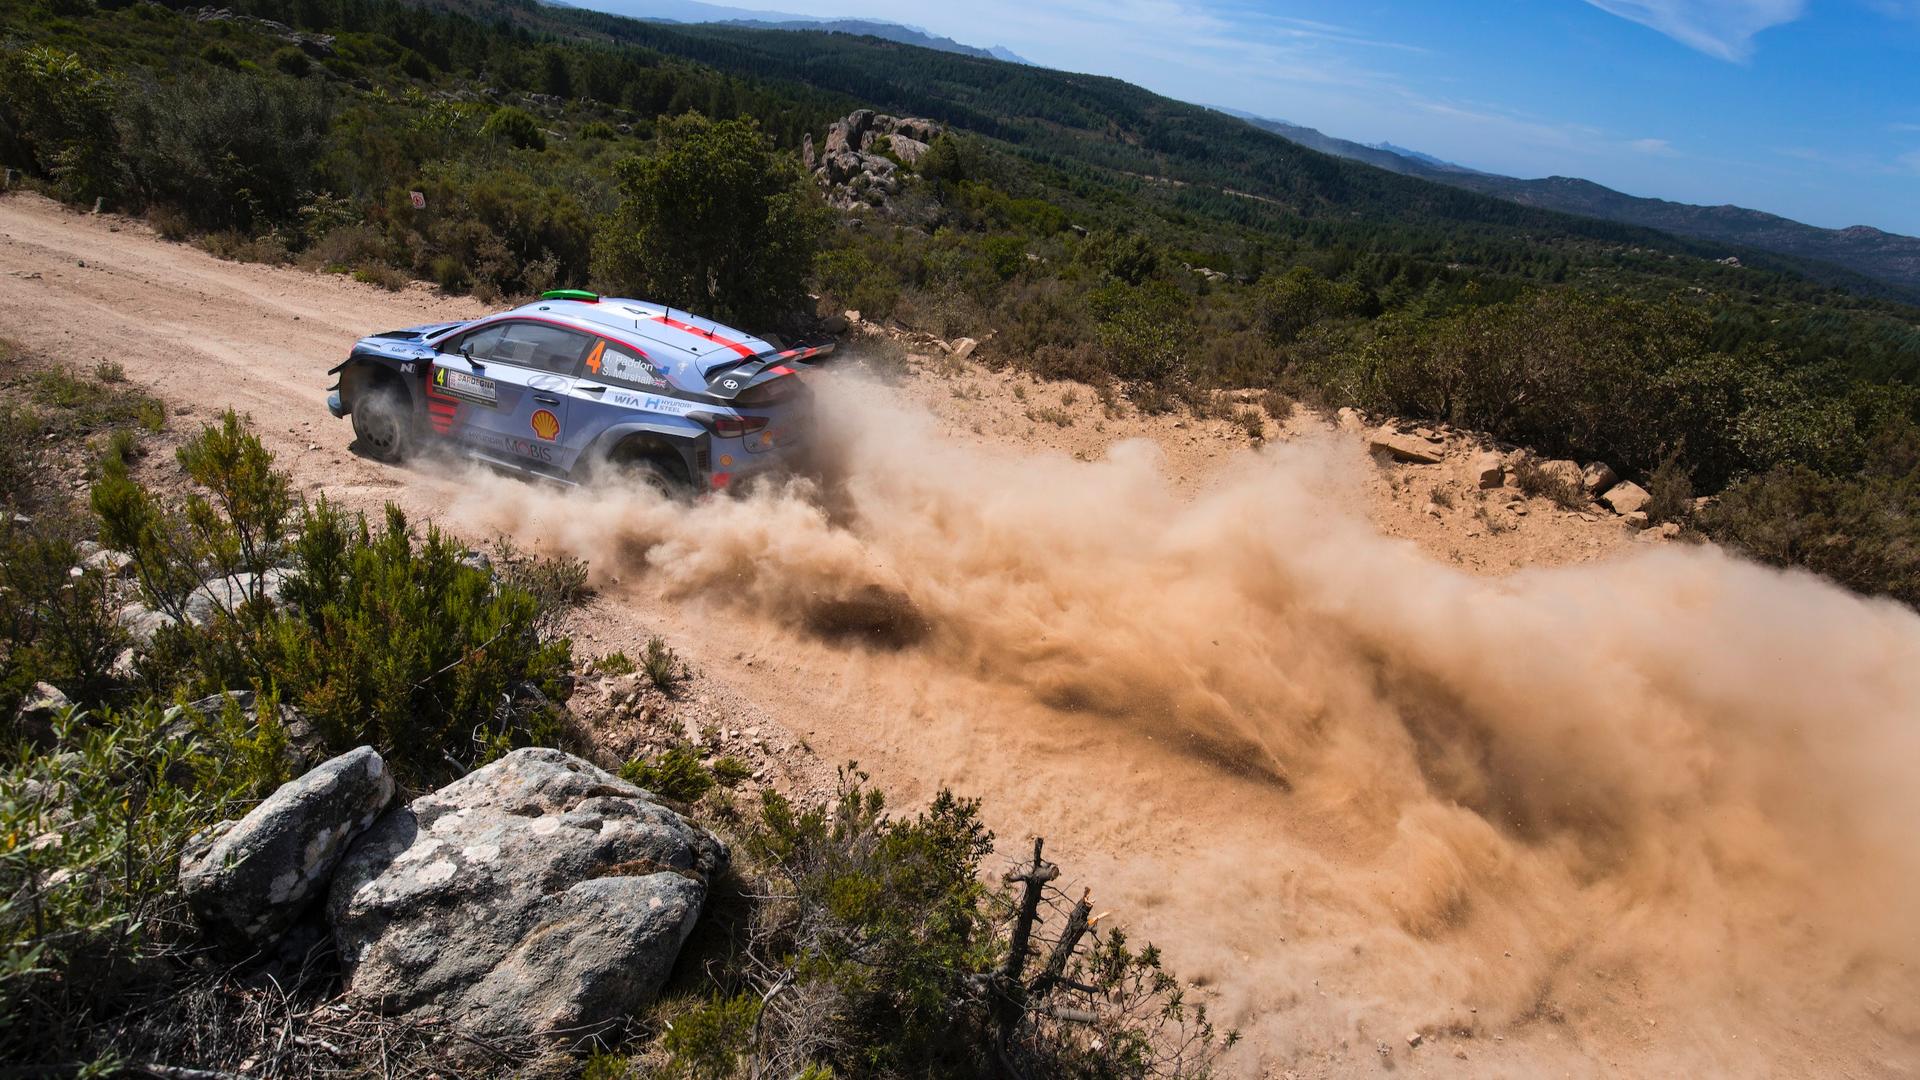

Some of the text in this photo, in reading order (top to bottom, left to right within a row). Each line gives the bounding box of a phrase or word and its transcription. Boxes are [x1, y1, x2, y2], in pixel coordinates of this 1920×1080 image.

[585, 340, 606, 375] 4
[615, 355, 654, 373] Paddon
[436, 367, 445, 386] 4
[457, 373, 496, 389] SARDEGNA
[613, 369, 654, 386] Marshall
[659, 405, 681, 413] STEEL
[504, 437, 552, 462] MOBIS
